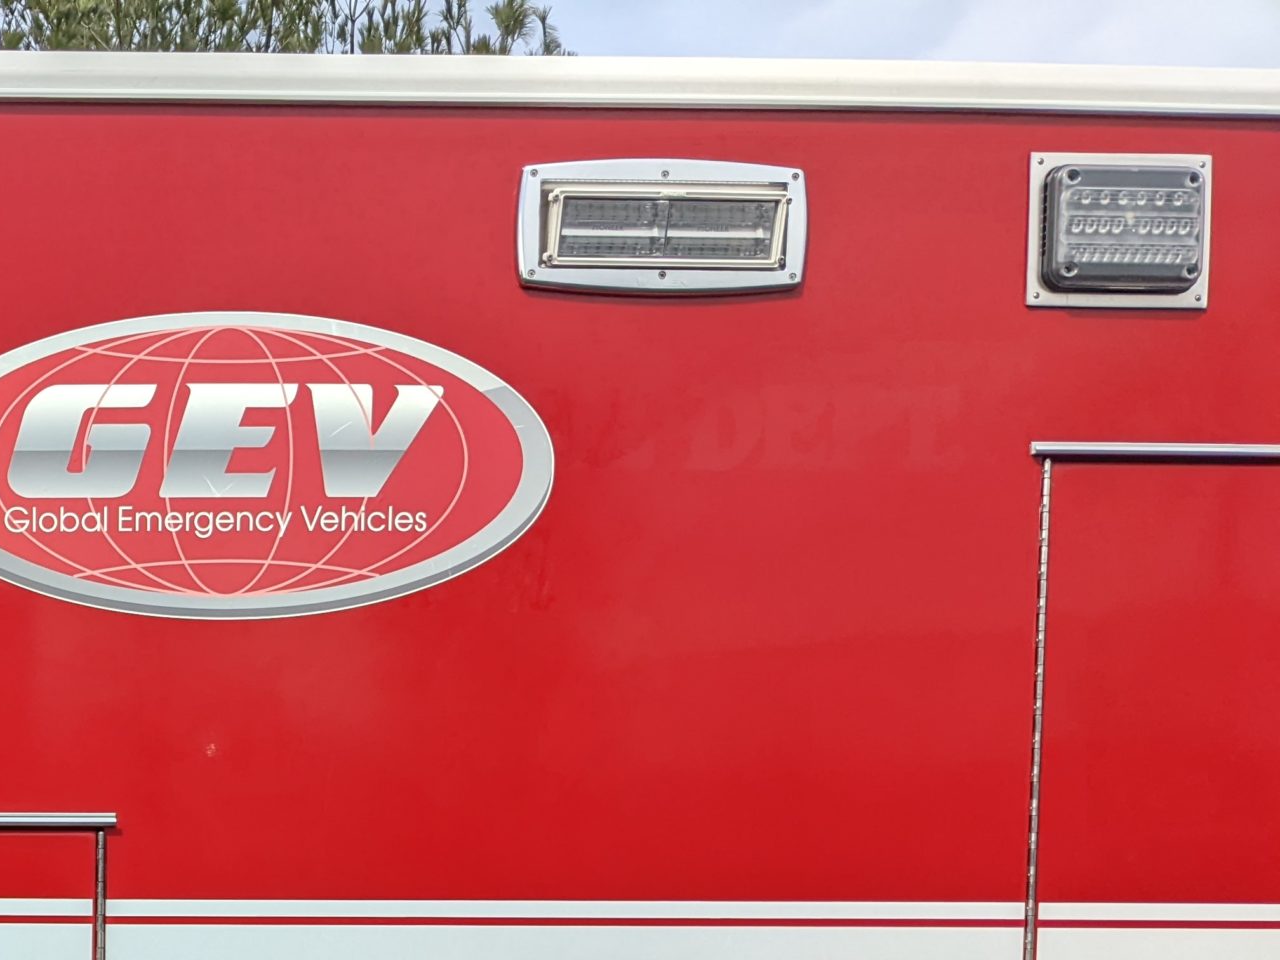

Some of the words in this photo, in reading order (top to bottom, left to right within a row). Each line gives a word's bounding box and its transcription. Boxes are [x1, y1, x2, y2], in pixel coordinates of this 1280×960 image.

[7, 383, 444, 499] GEV
[4, 505, 107, 534] Global
[118, 505, 291, 538] Emergency
[301, 505, 428, 534] Vehicles
